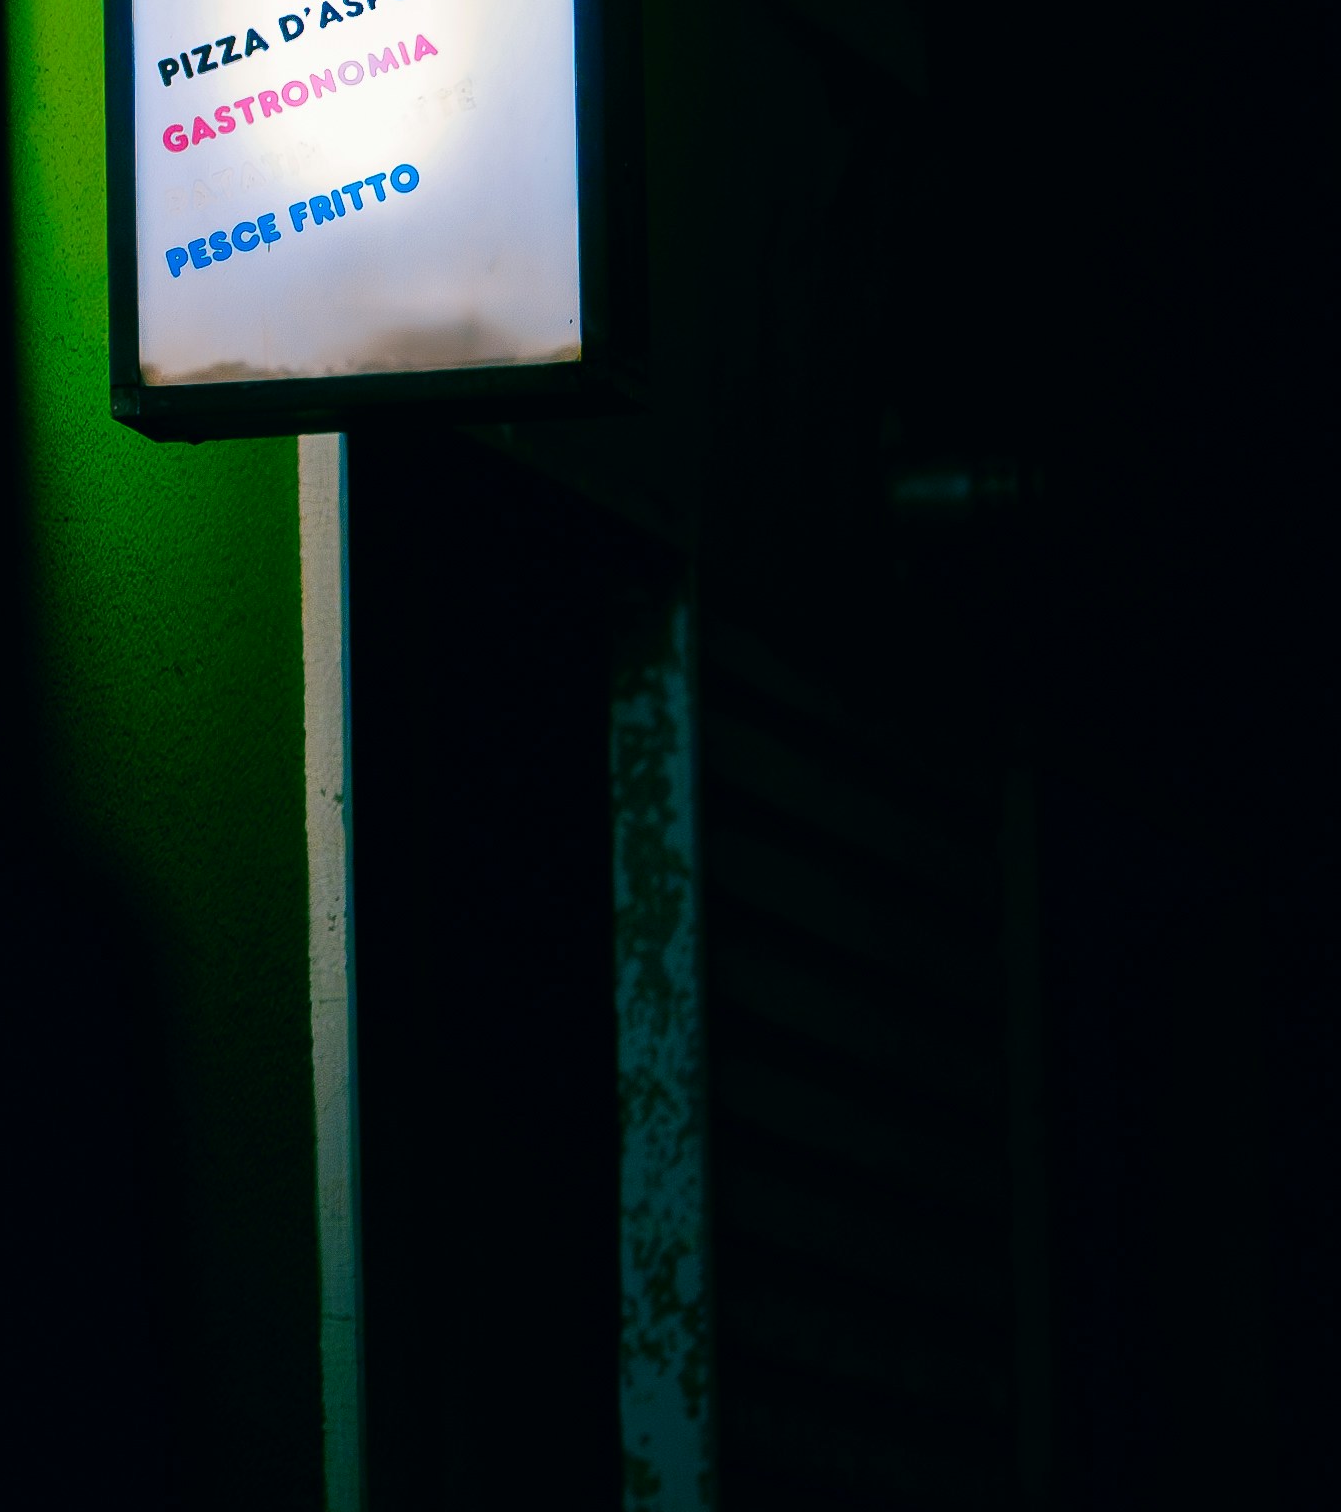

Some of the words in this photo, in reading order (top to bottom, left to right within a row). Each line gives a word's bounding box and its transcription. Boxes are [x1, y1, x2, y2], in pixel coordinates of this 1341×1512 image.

[157, 26, 270, 88] PIZZA
[162, 33, 439, 154] GASTRONOMIA
[165, 213, 282, 278] PESCE
[289, 163, 421, 236] FRITTO
